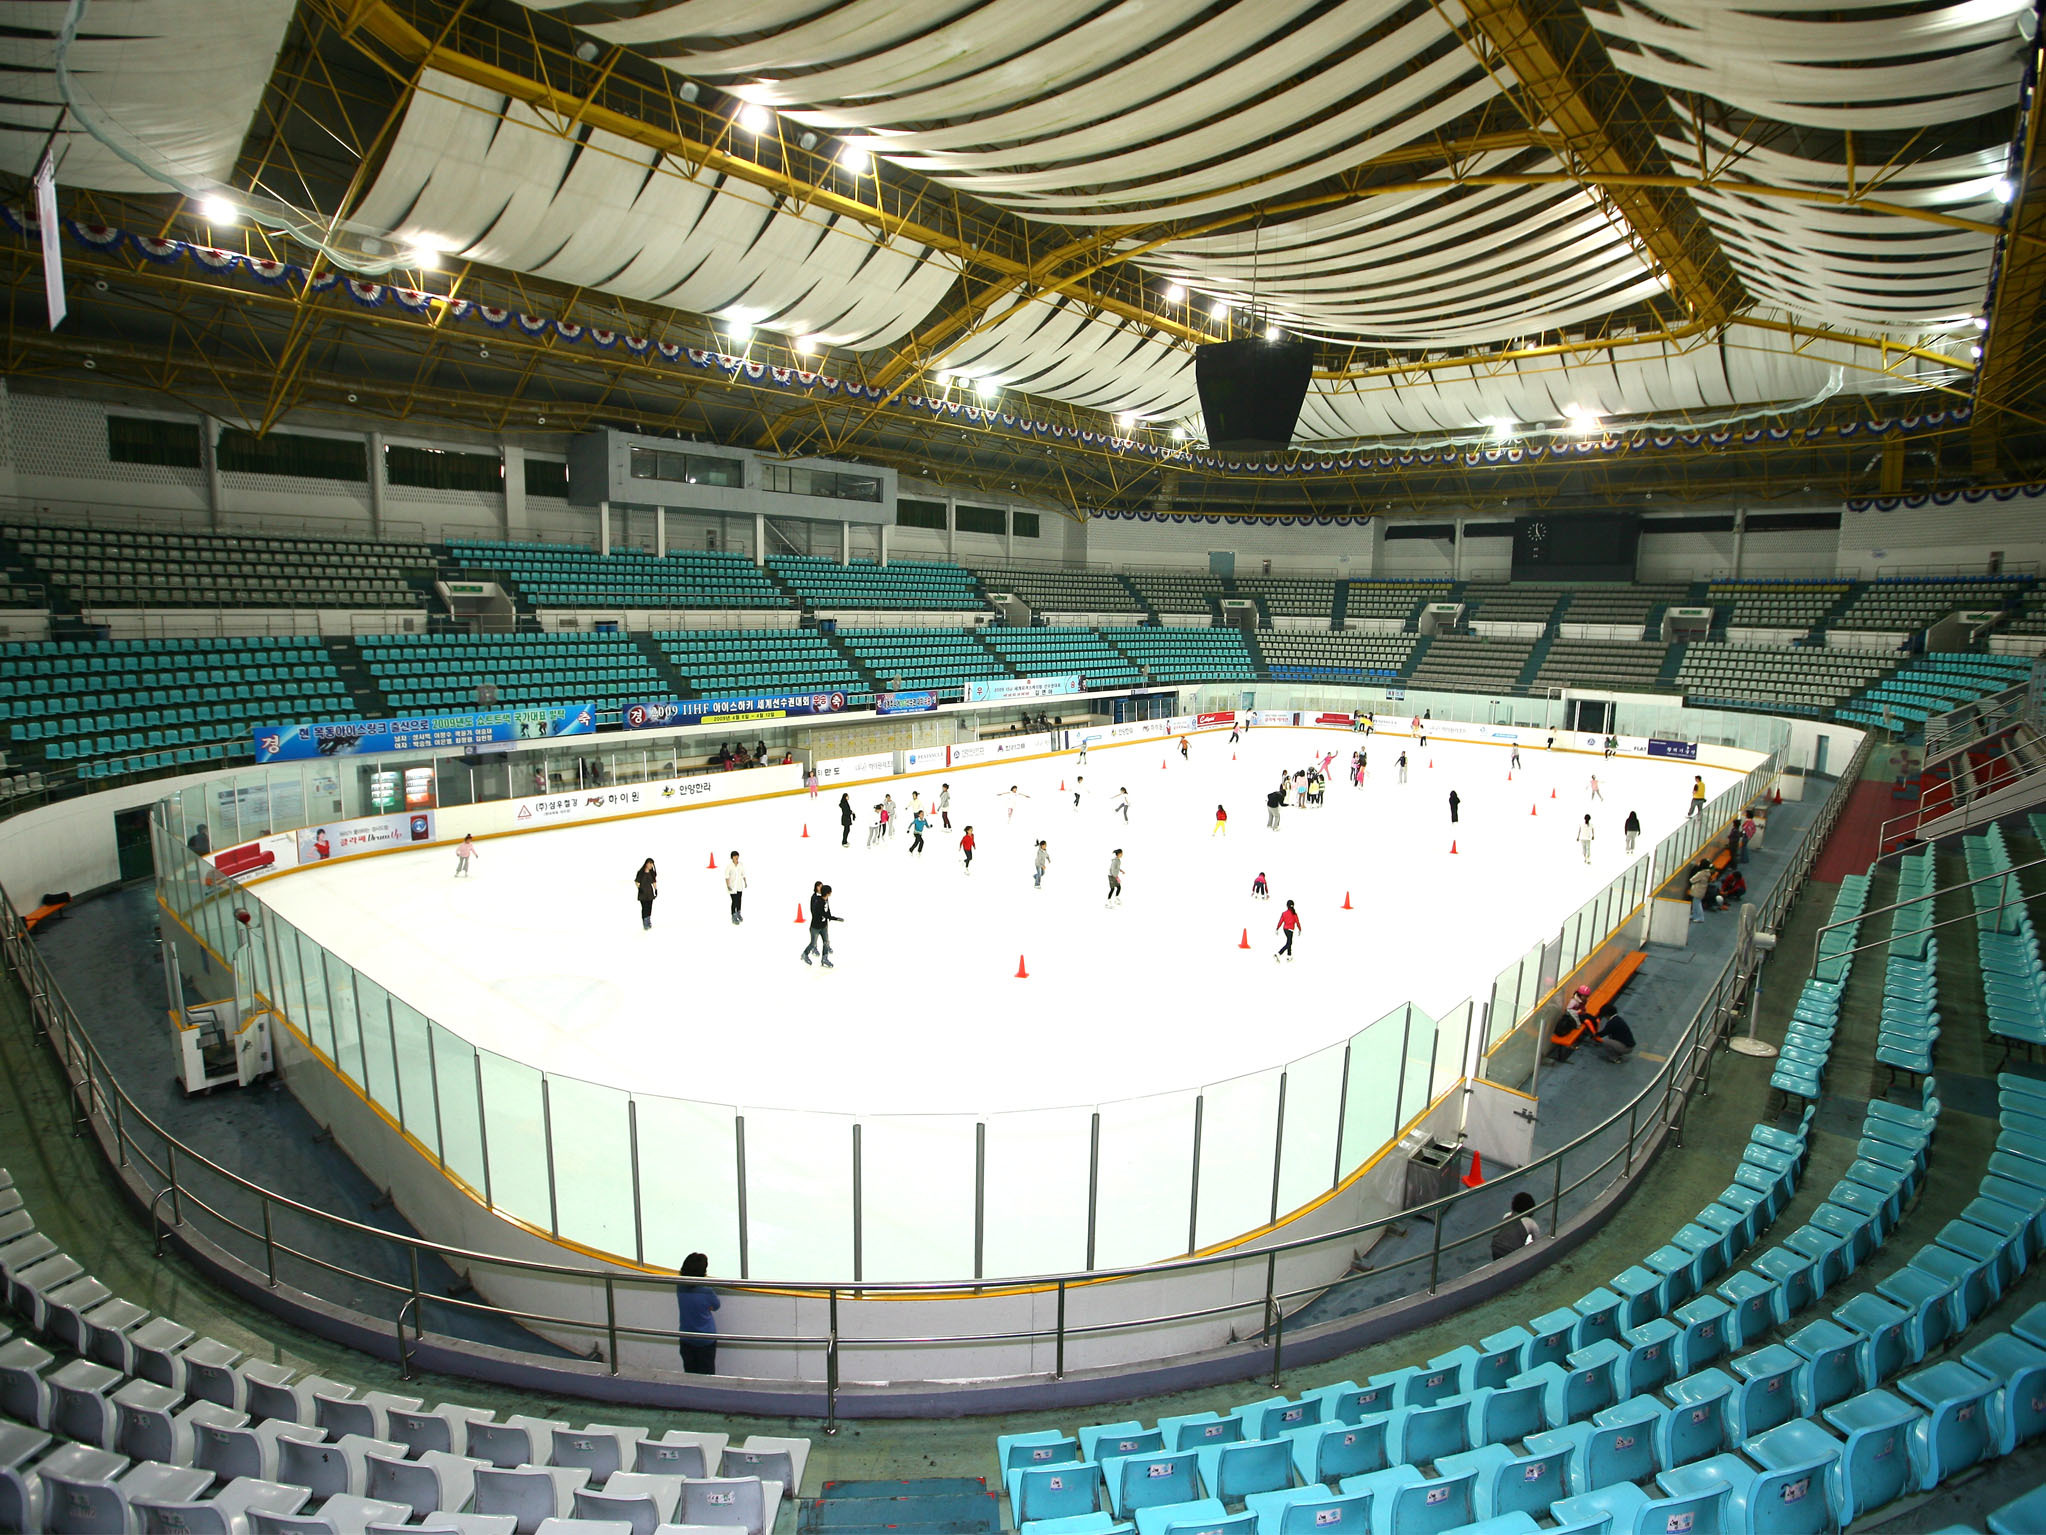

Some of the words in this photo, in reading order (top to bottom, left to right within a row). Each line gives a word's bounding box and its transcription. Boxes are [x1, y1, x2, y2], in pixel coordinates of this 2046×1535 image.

[650, 704, 678, 718] 2009
[683, 702, 709, 715] IIHF
[713, 699, 754, 713] 아이스하키
[756, 695, 810, 710] 세계선수권대회
[313, 721, 387, 740] 목동아이스링크
[432, 716, 474, 730] 2009년도
[514, 710, 547, 723] 국가대표
[261, 734, 281, 754] 경
[608, 791, 640, 805] 하이원
[679, 782, 712, 796] 안양한라
